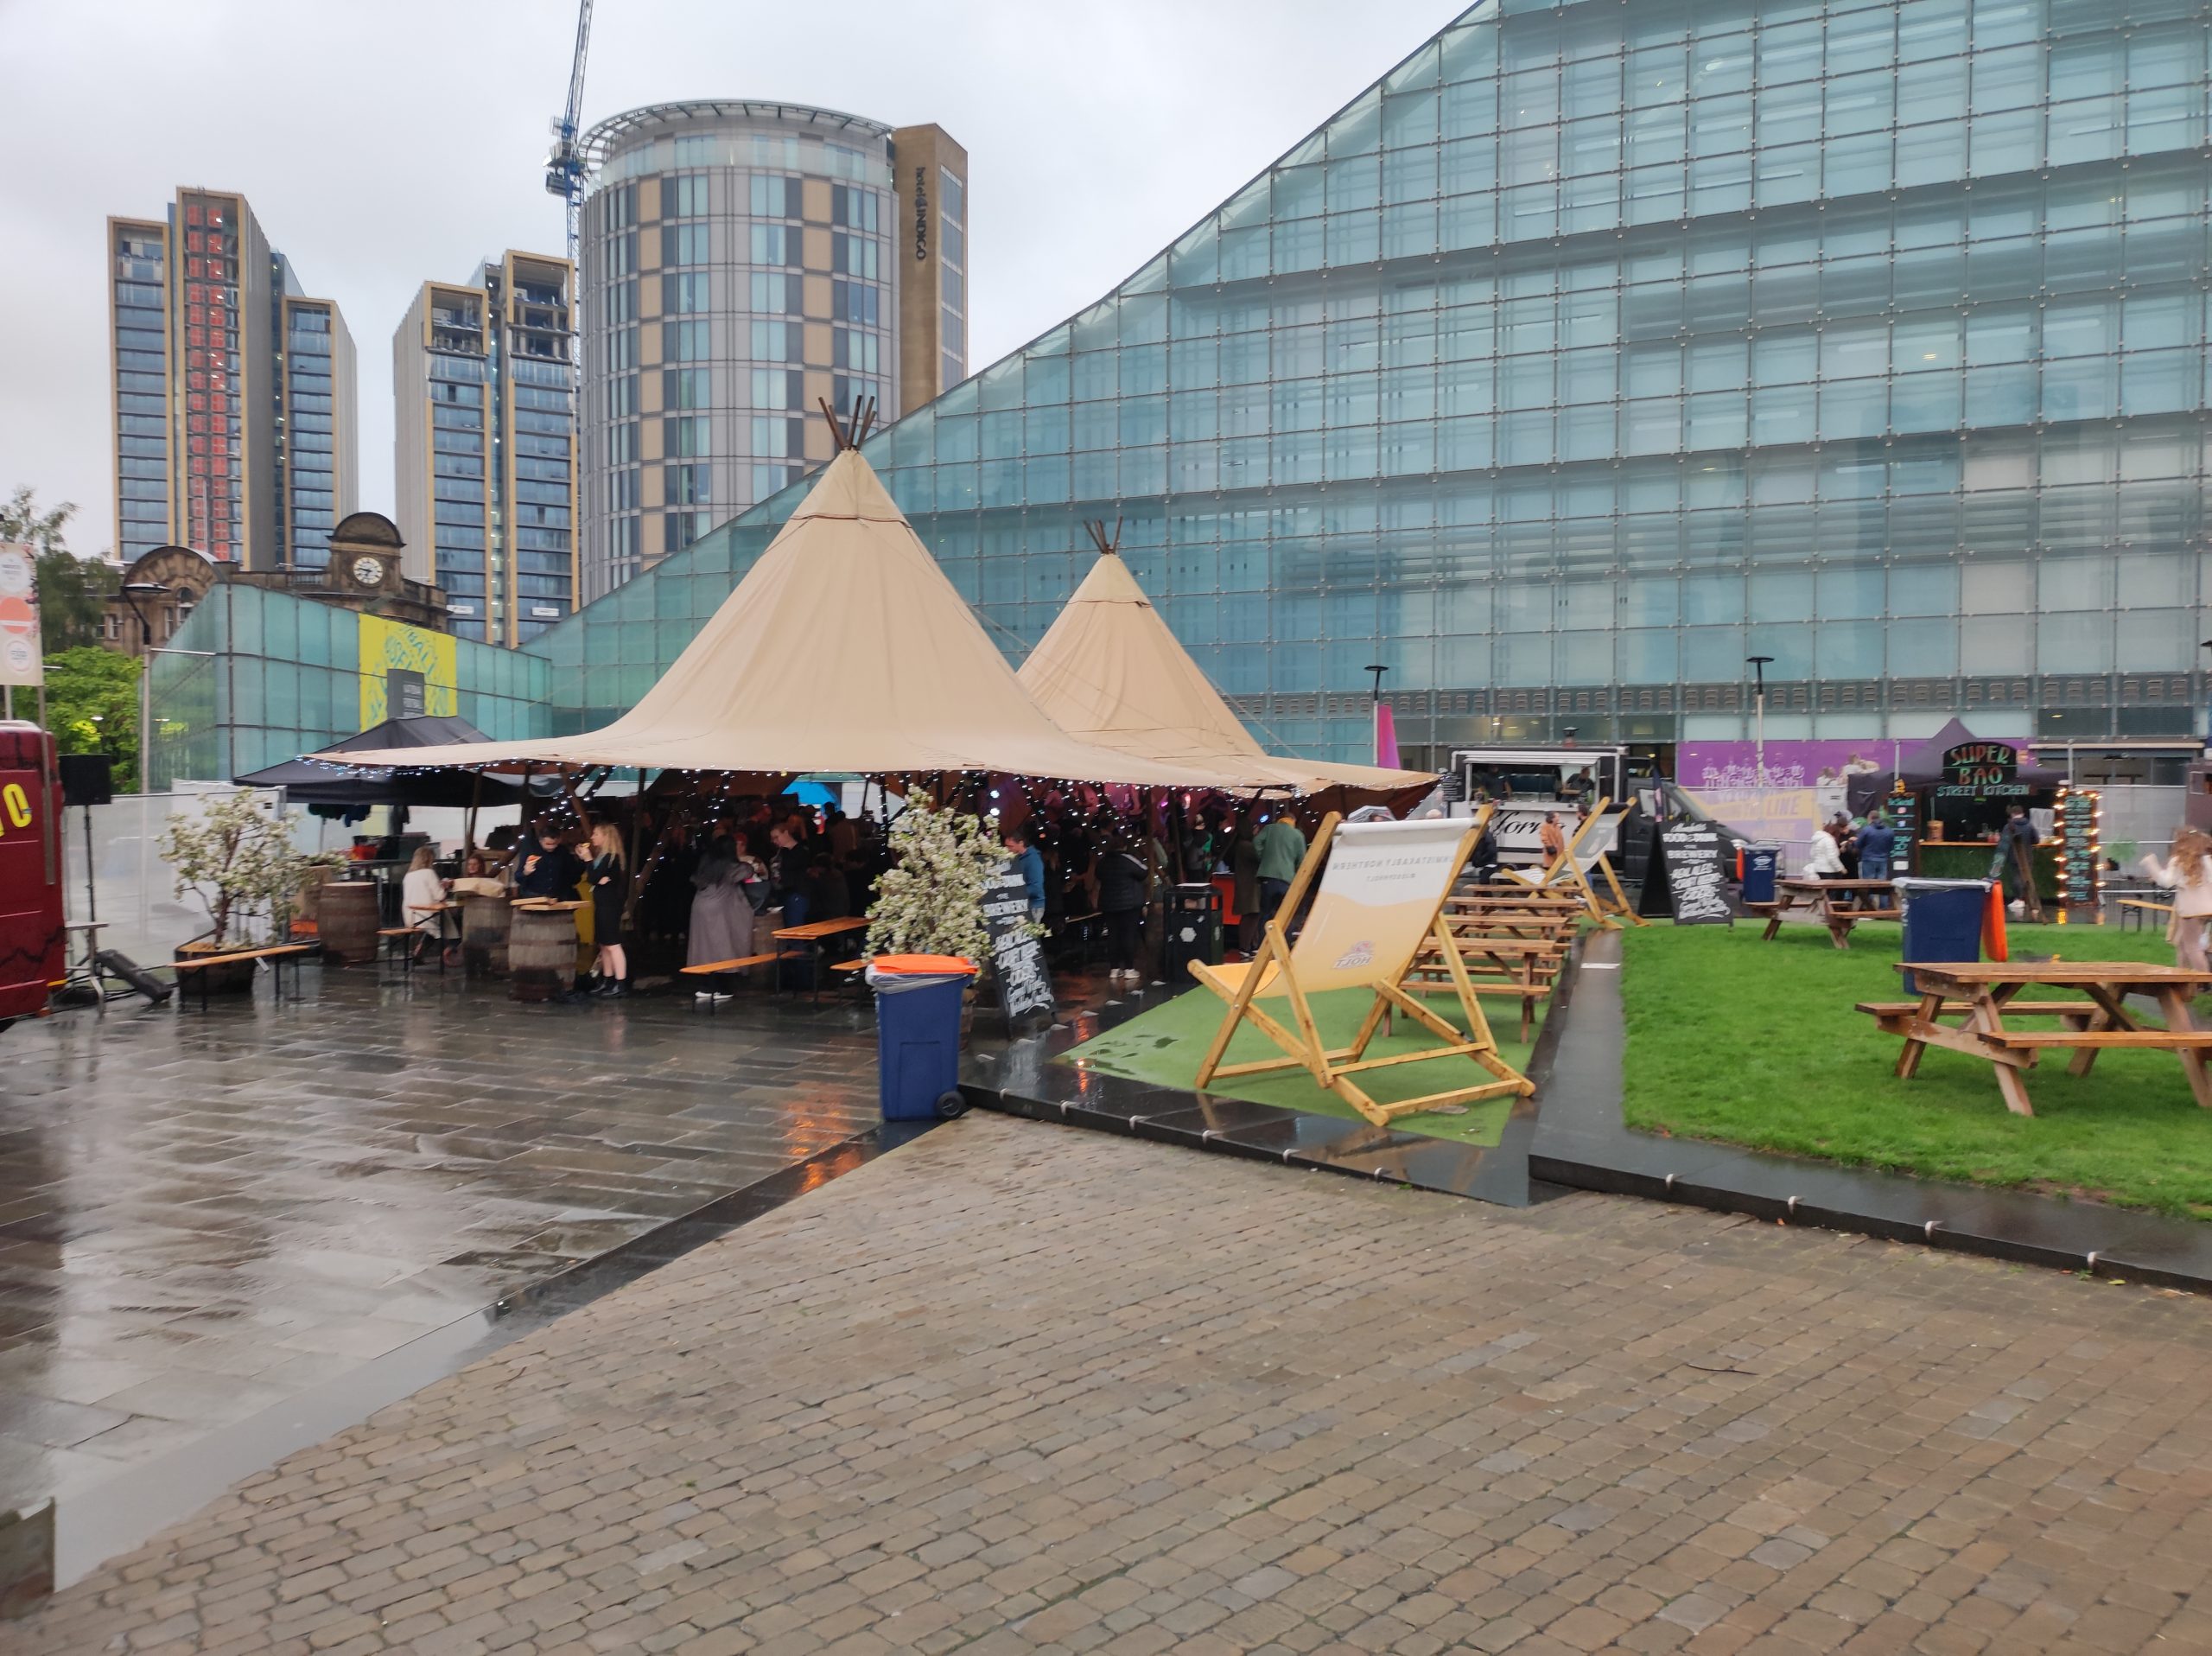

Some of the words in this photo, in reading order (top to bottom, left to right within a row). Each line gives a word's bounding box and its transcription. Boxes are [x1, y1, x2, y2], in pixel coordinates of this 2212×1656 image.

[915, 166, 926, 197] hotel
[916, 208, 927, 260] INDIGO
[1949, 744, 2011, 766] SUPER
[1958, 767, 2004, 785] BAO
[1936, 785, 1978, 797] STREET
[1983, 784, 2031, 796] KITCHEN
[1766, 794, 1802, 817] LINE
[1667, 850, 1719, 858] BREWERY
[982, 899, 1029, 917] BREWERY
